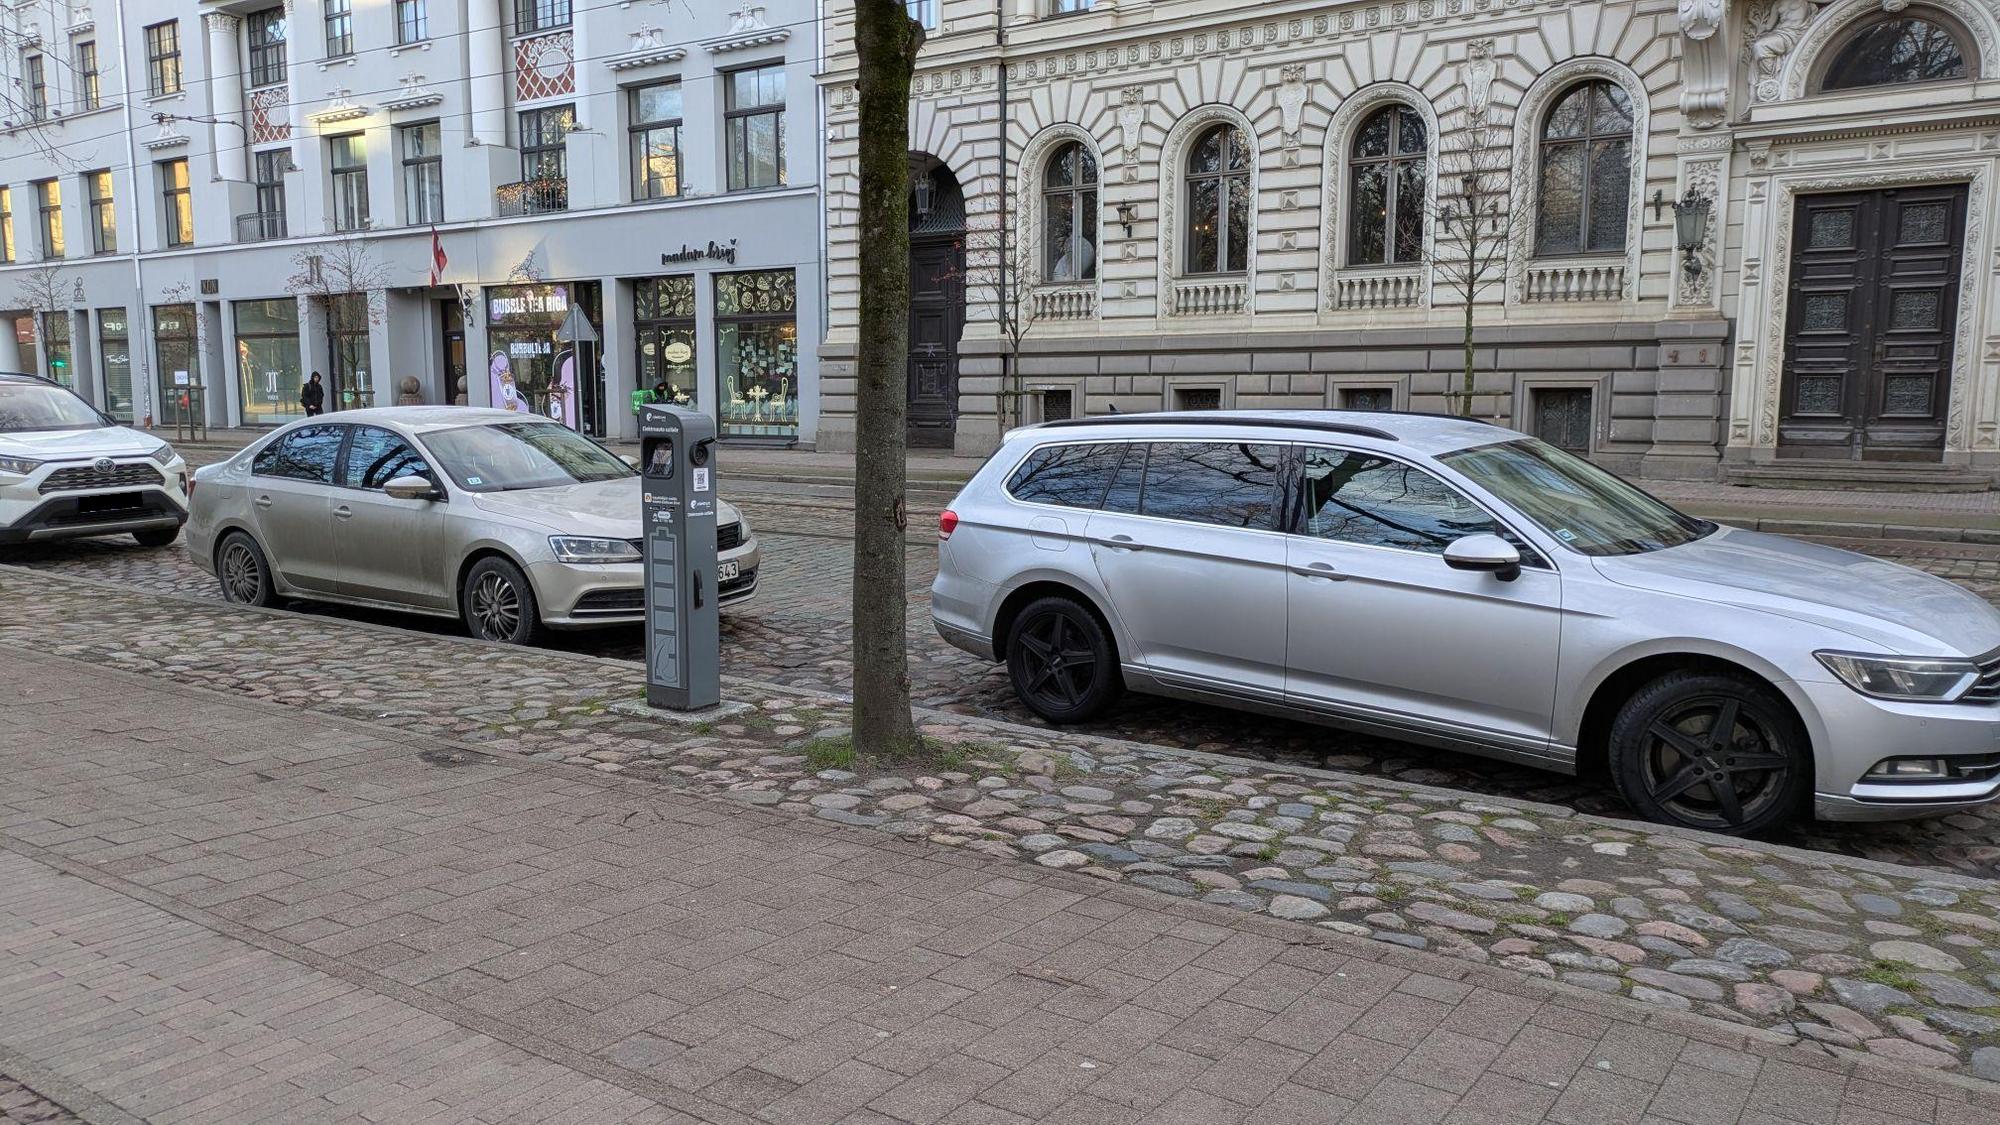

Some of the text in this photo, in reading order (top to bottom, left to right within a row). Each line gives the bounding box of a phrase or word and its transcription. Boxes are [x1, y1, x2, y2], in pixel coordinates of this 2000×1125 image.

[493, 298, 526, 314] BUBBLE
[546, 295, 568, 312] RIGA
[718, 563, 737, 579] 643
